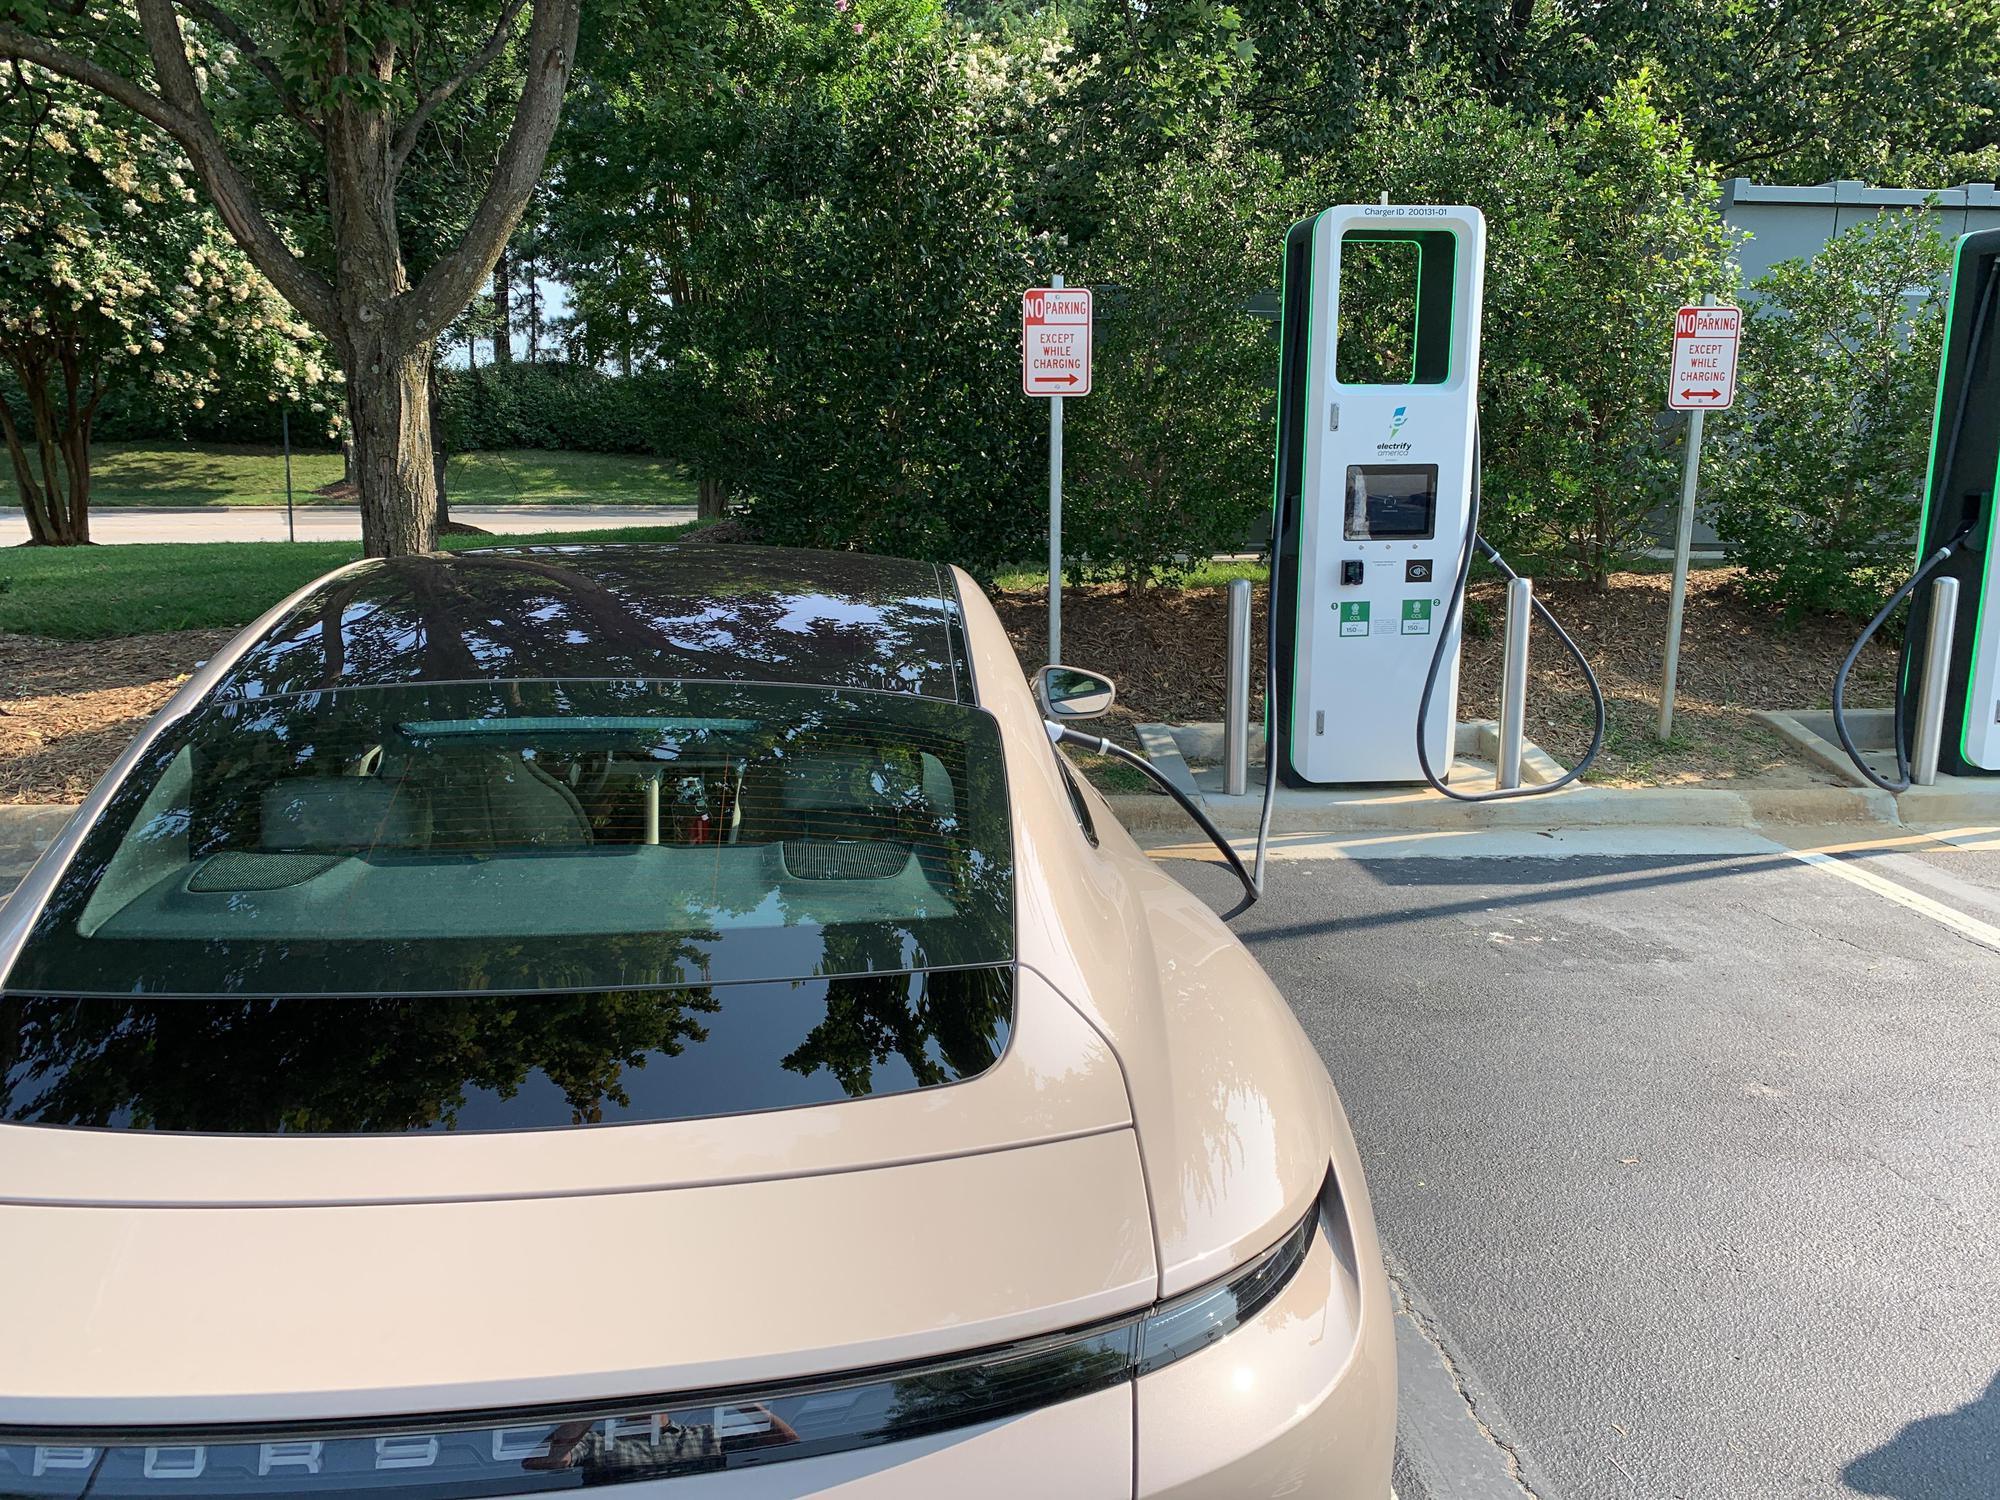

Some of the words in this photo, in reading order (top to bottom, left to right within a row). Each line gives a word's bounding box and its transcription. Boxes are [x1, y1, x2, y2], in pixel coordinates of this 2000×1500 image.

[1364, 207, 1395, 217] Charger
[1396, 208, 1405, 216] ID
[1408, 208, 1447, 216] 200131-01
[1025, 298, 1044, 319] NO
[1045, 301, 1087, 315] PARKING
[1678, 314, 1696, 334] NO
[1697, 317, 1736, 331] PARKING
[1040, 333, 1075, 344] EXCEPT
[1042, 346, 1071, 356] WHILE
[1689, 344, 1723, 355] EXCEPT
[1033, 358, 1081, 369] CHARGING
[1690, 358, 1718, 368] WHILE
[1680, 371, 1726, 382] CHARGING
[1376, 442, 1412, 451] electrify
[33, 1400, 774, 1479] PORSCHE
